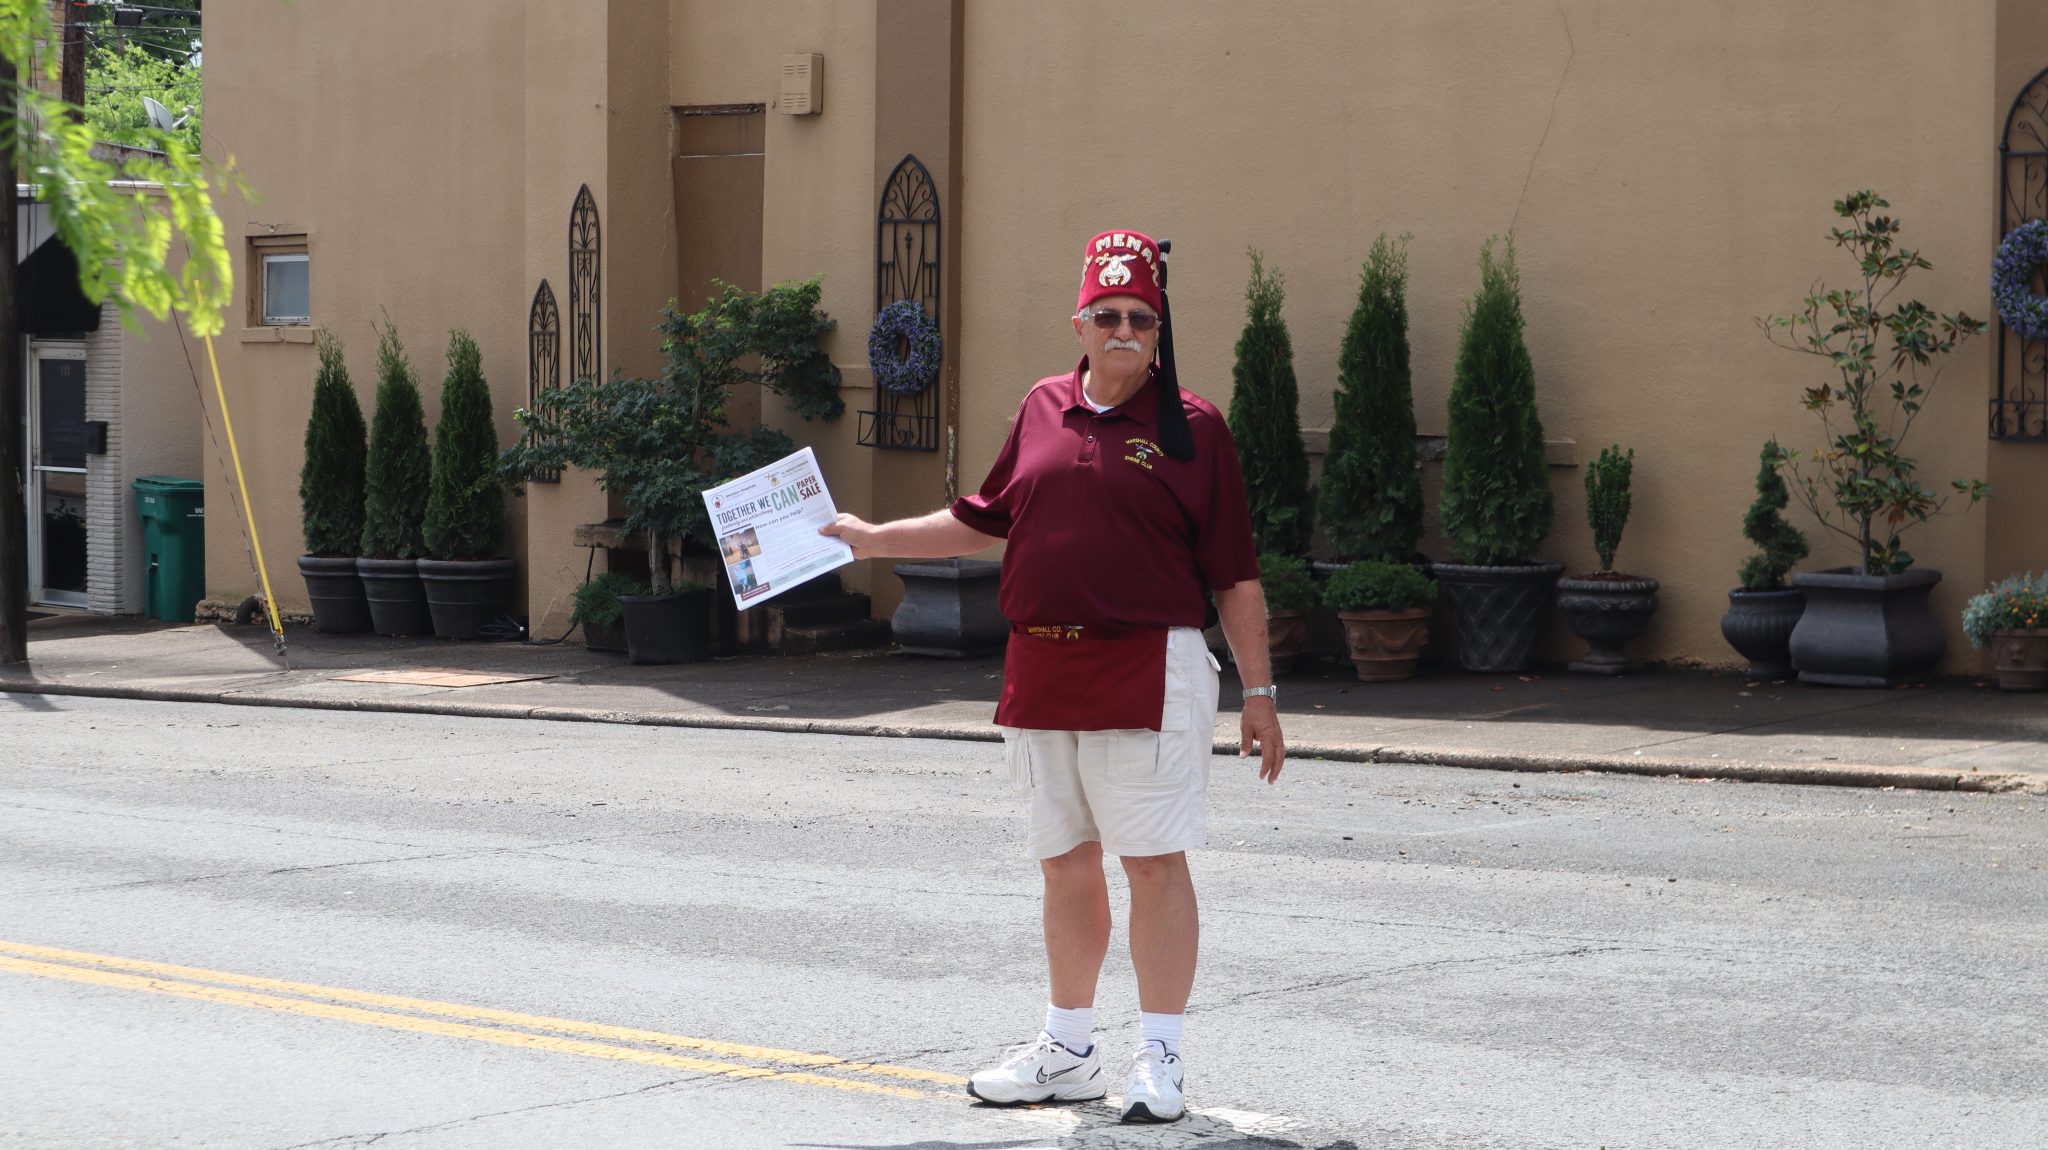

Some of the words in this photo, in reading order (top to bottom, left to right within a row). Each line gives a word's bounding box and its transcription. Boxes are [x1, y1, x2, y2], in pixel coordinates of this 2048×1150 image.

[1149, 442, 1164, 456] COUNTY
[1141, 460, 1153, 470] CLUB
[796, 475, 817, 490] PAPER
[716, 502, 757, 526] TOGETHER
[757, 495, 771, 510] WE
[771, 485, 800, 512] CAN
[800, 483, 821, 501] SALE
[755, 522, 768, 530] How
[768, 518, 779, 526] can
[779, 514, 790, 524] you
[790, 507, 804, 519] help?
